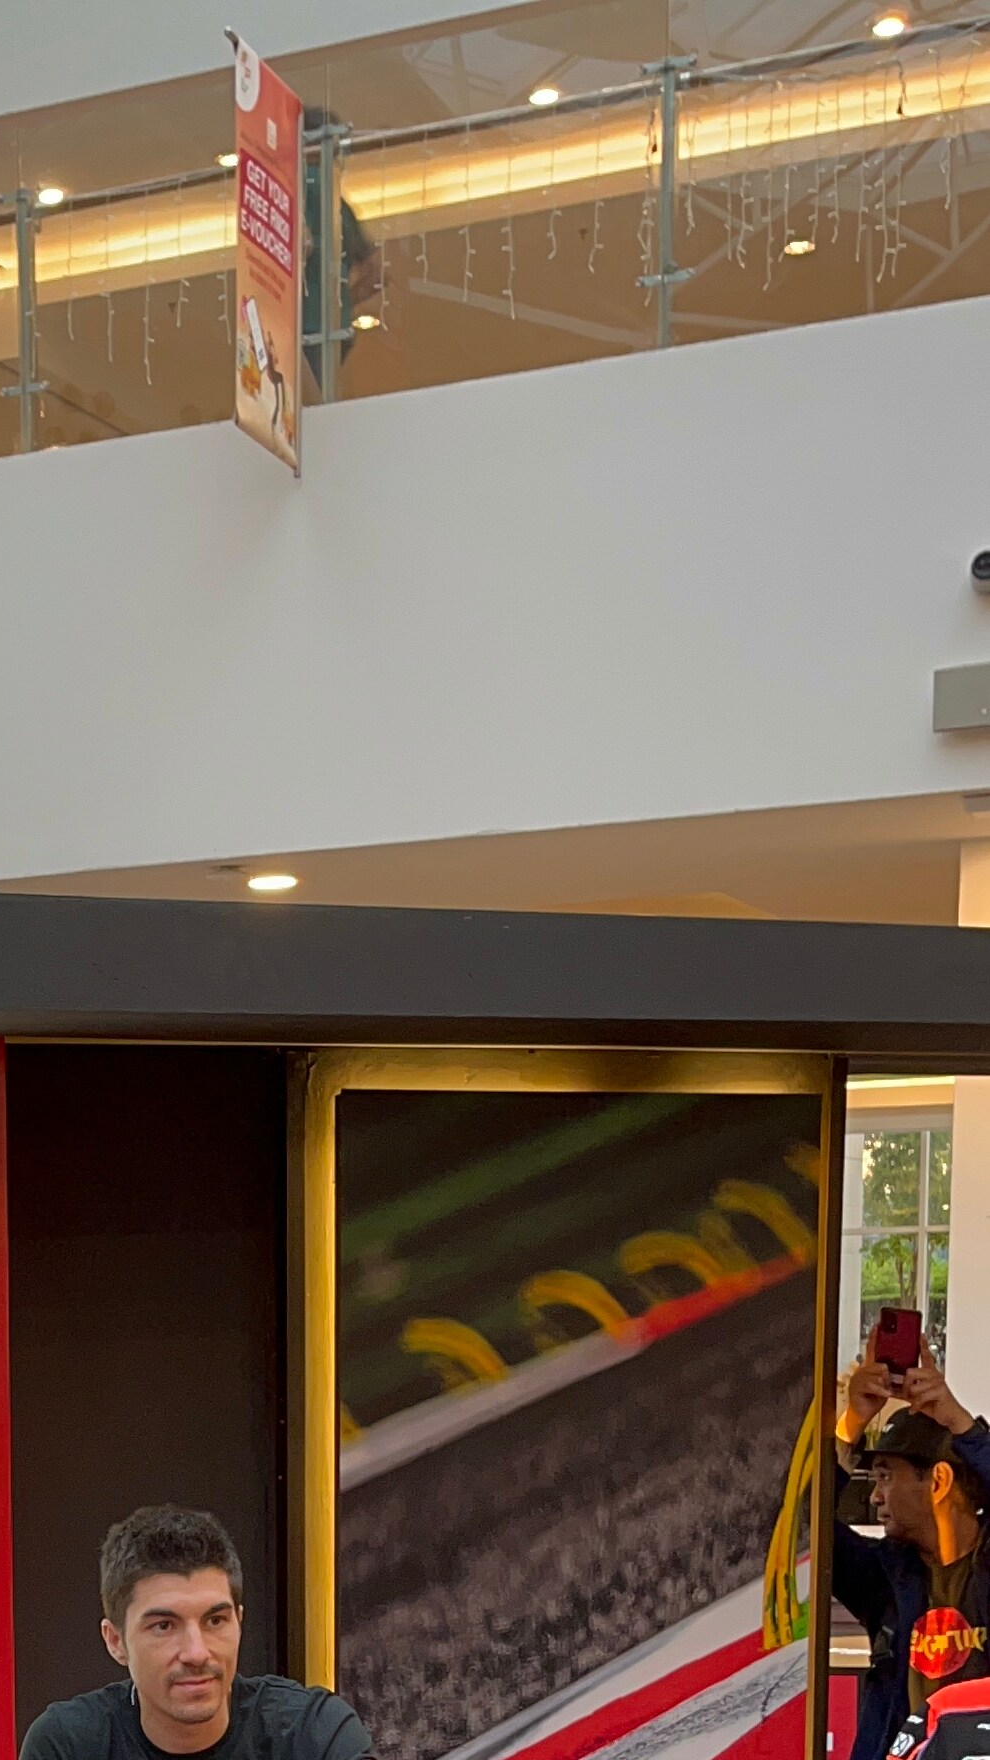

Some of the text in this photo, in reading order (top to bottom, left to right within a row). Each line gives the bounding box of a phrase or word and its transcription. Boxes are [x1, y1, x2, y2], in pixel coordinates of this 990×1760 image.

[246, 159, 267, 192] GET
[243, 184, 269, 222] FREE
[241, 207, 291, 271] E-VOUCHER
